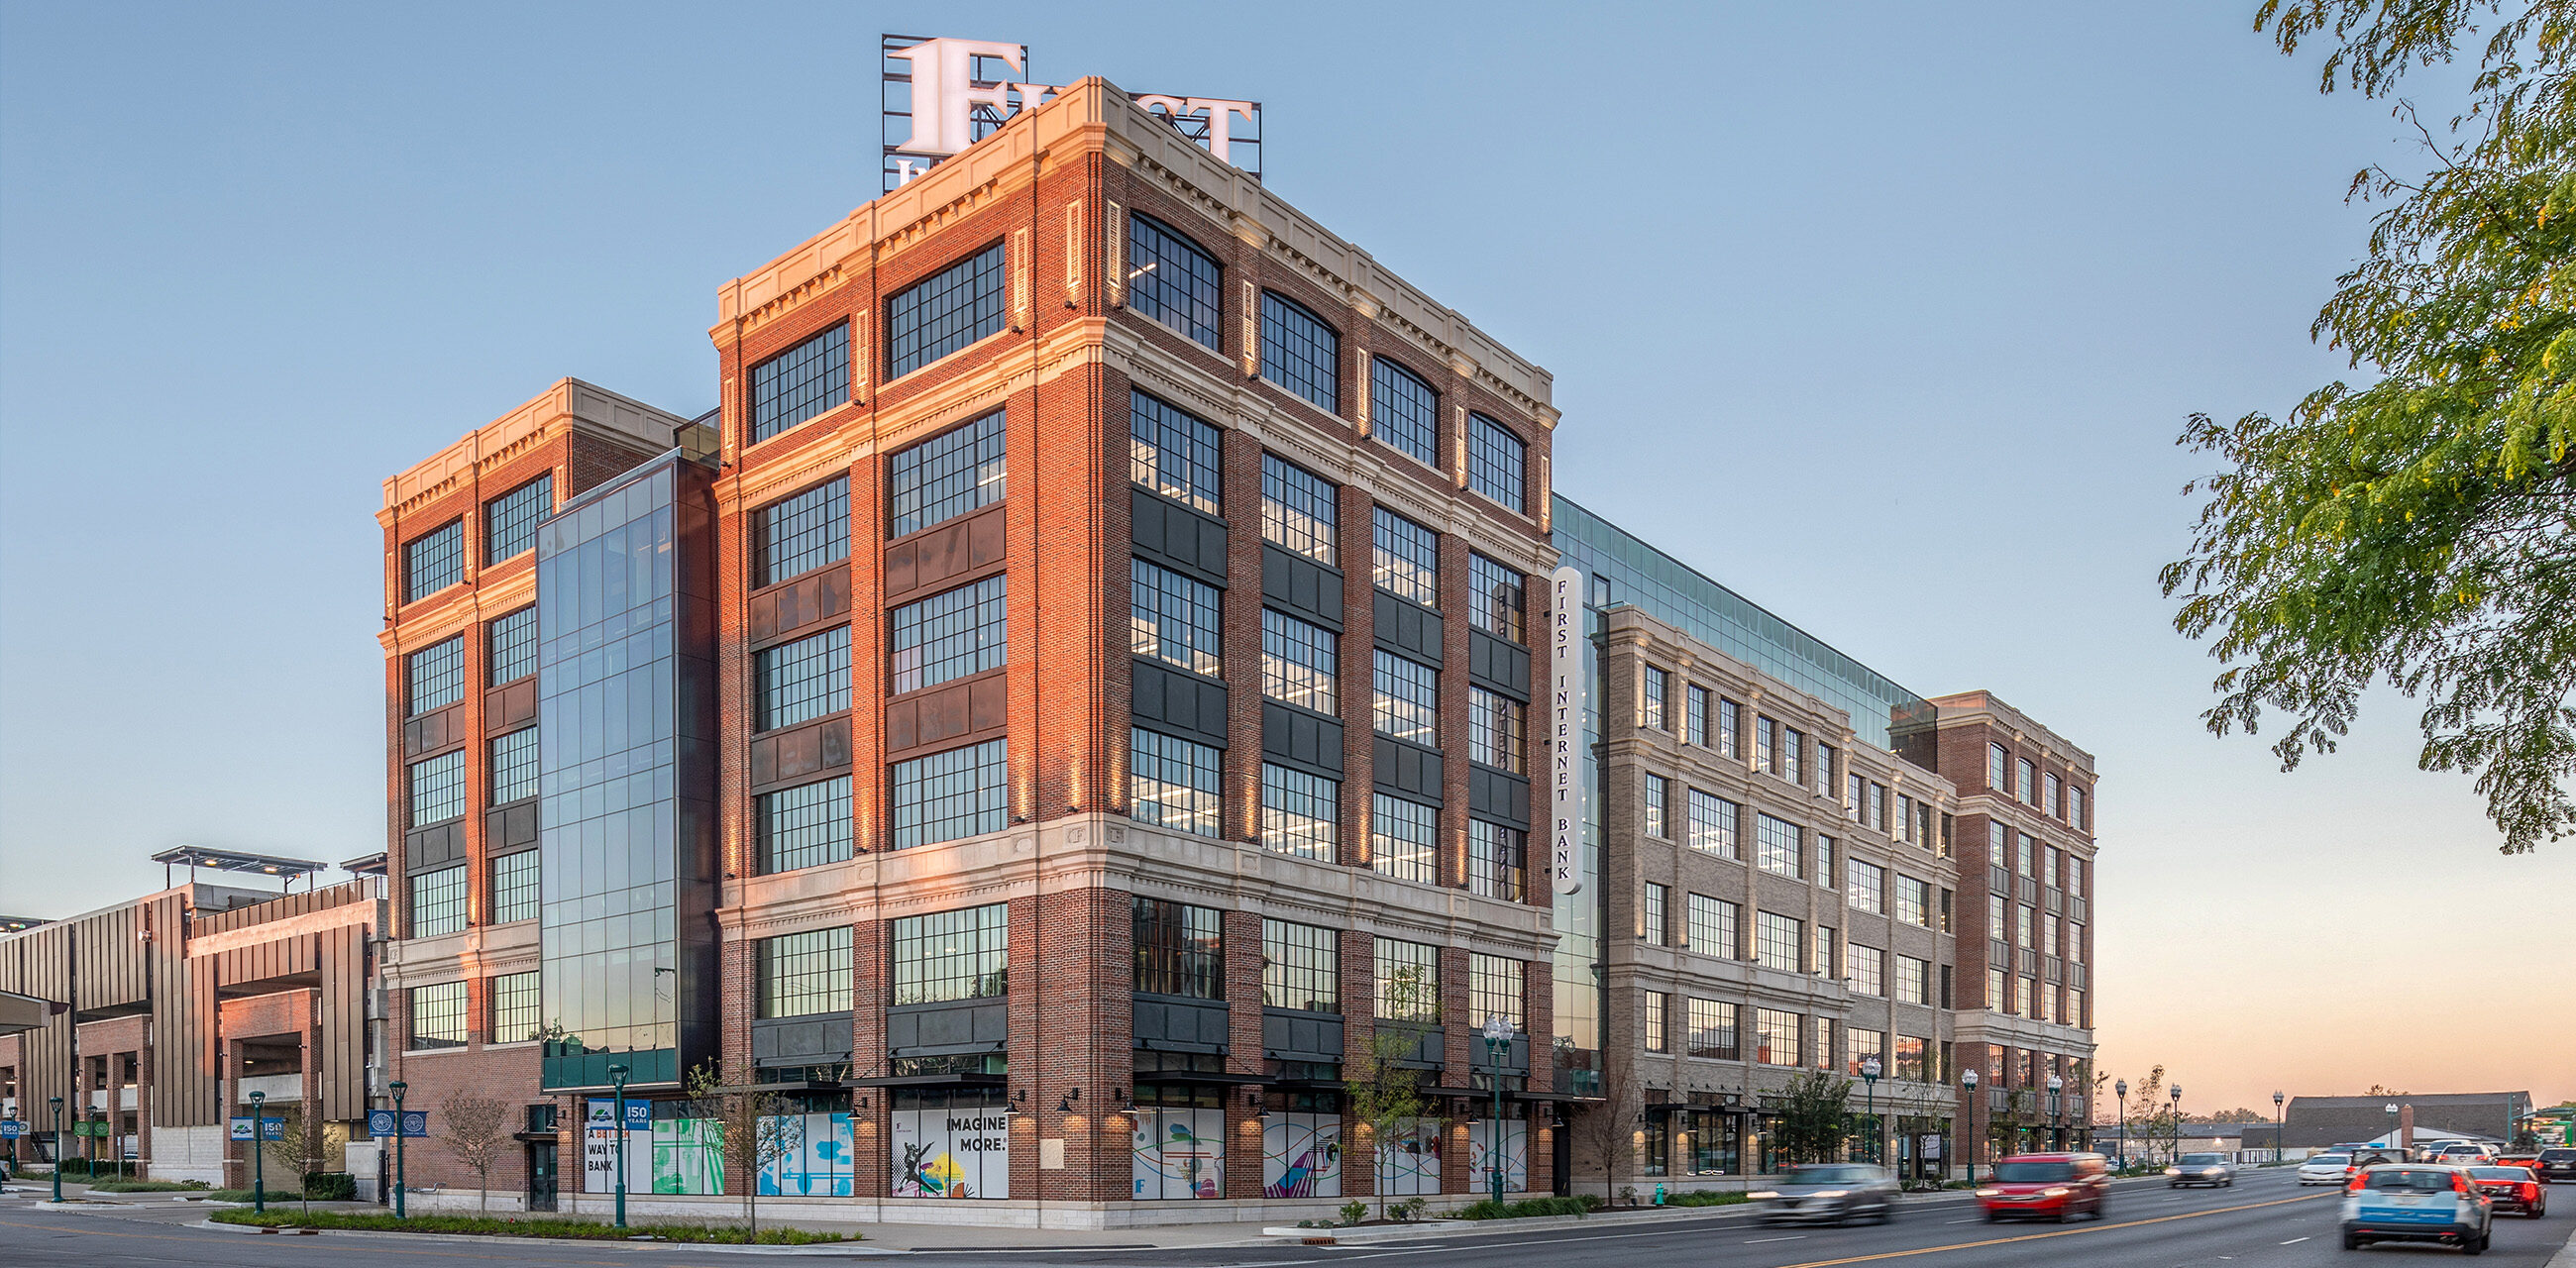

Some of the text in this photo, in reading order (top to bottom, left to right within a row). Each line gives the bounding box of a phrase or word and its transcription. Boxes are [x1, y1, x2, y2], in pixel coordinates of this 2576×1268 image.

[887, 38, 1252, 164] FIT
[1556, 580, 1570, 881] FIRST INTERNET BANK
[627, 1107, 647, 1117] 150
[946, 1116, 1007, 1131] IMAGINE
[588, 1144, 607, 1155] WAY
[588, 1160, 612, 1171] BANK
[1134, 1179, 1146, 1194] F
